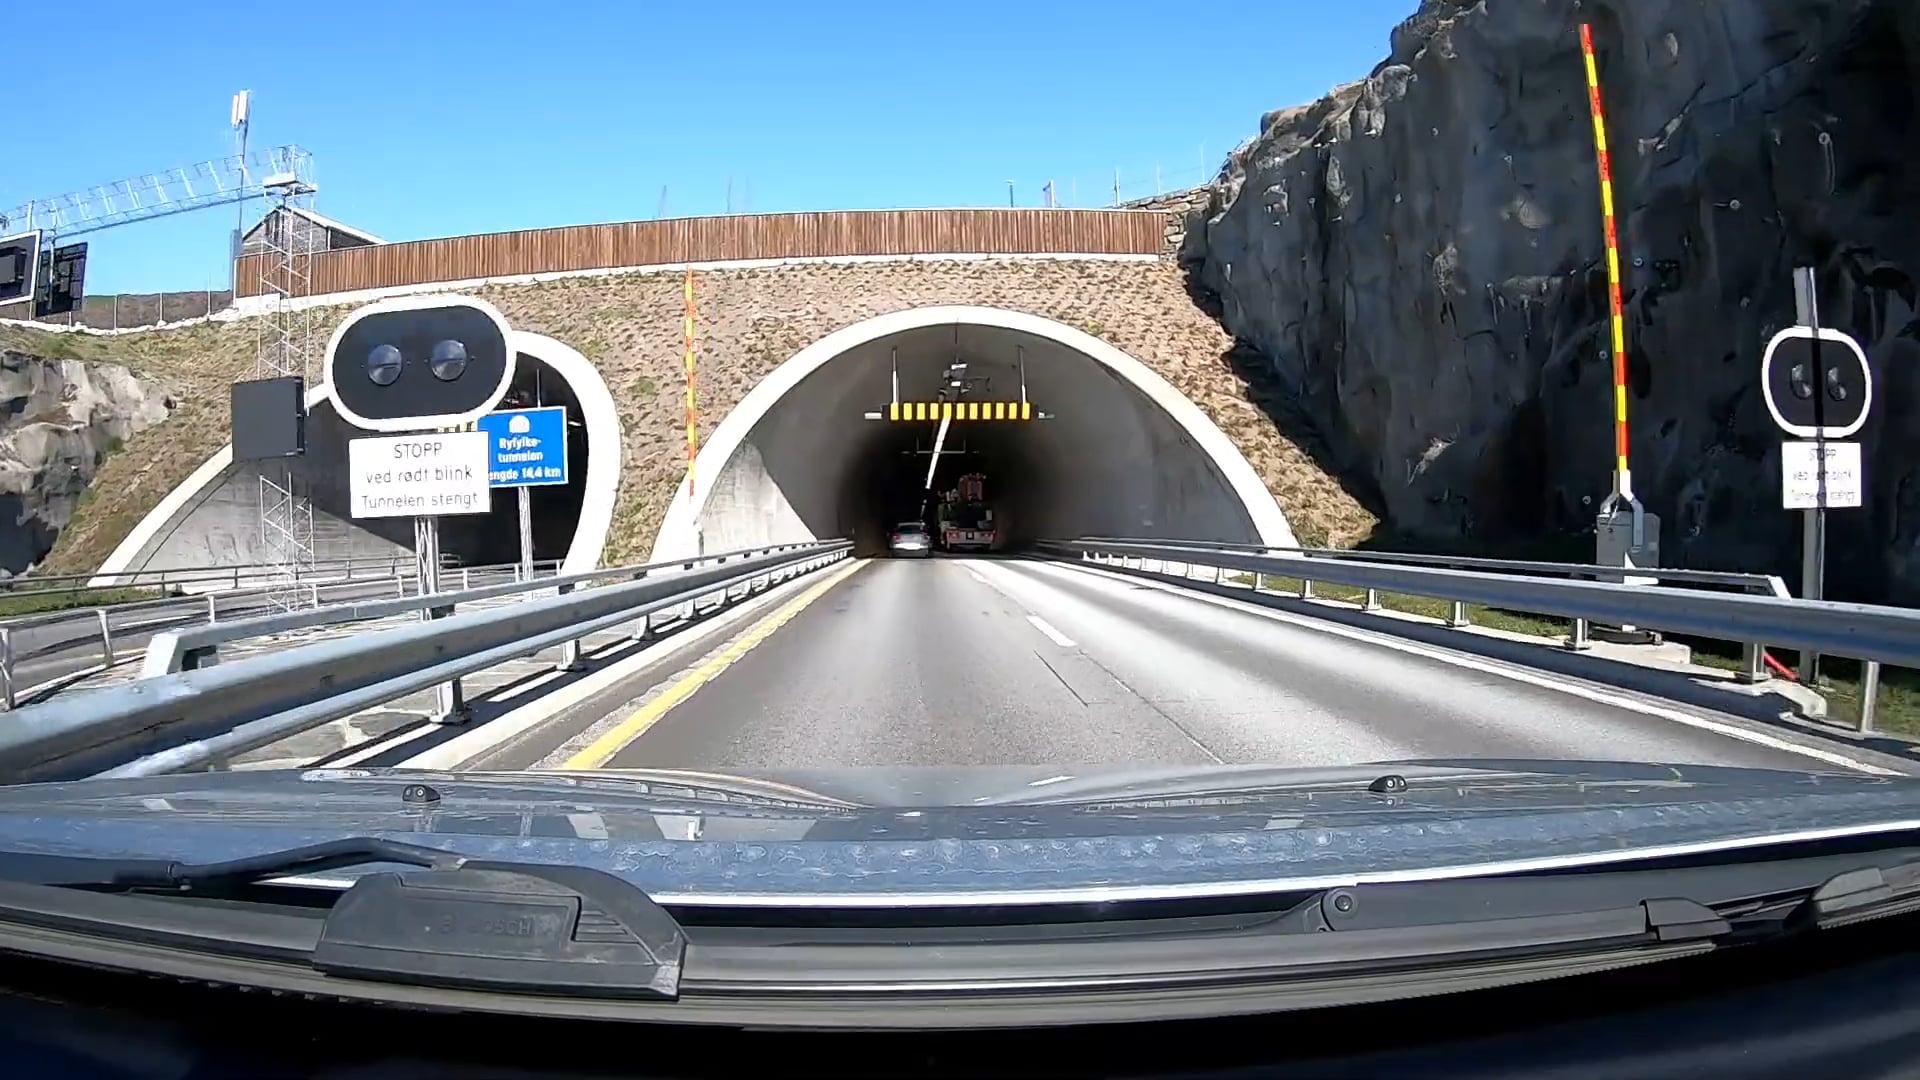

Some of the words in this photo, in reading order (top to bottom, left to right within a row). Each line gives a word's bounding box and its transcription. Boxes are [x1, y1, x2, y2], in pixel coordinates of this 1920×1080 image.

[394, 442, 442, 459] STOPP
[499, 437, 541, 451] Ryfylke-
[498, 450, 543, 463] tunnelen
[366, 469, 391, 484] ved
[398, 467, 428, 482] rødt
[435, 464, 472, 481] blink
[488, 468, 519, 482] engde
[544, 466, 561, 478] km
[361, 494, 425, 510] Tunnelen
[431, 492, 478, 509] stengt
